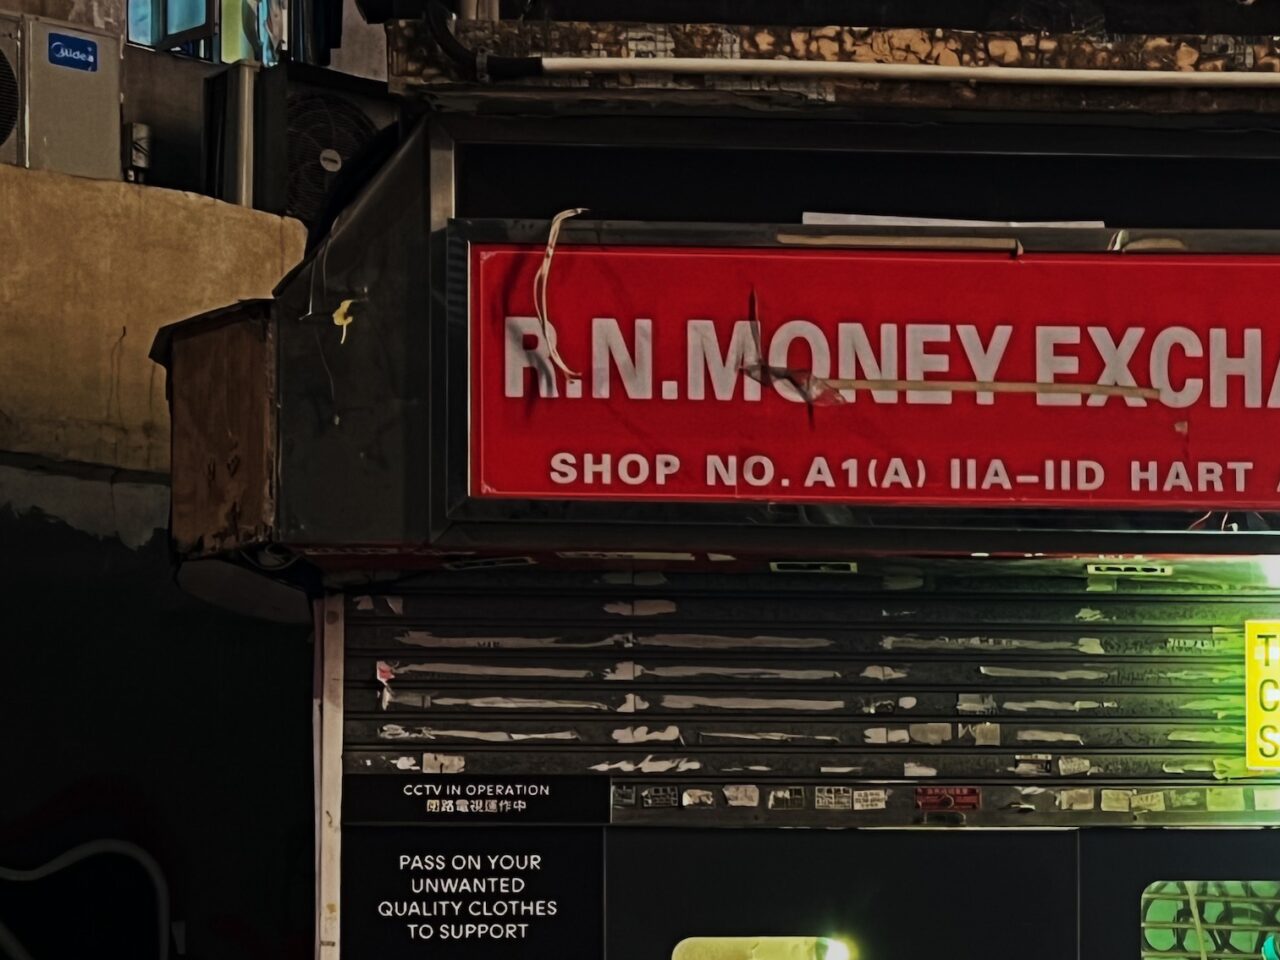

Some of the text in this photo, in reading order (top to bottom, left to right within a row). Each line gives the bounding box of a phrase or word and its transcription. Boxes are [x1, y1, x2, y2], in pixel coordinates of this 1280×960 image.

[51, 42, 94, 62] Midea
[549, 451, 682, 487] SHOP
[705, 453, 791, 488] NO.
[803, 456, 928, 490] A1(A)
[1130, 460, 1255, 493] HART
[402, 784, 551, 797] CCTV IN OPERATION
[398, 854, 542, 871] PASS ON YOUR
[410, 877, 526, 894] UNWANTED
[377, 900, 559, 918] QUALITY CLOTHES
[406, 923, 530, 940] TO SUPPORT
